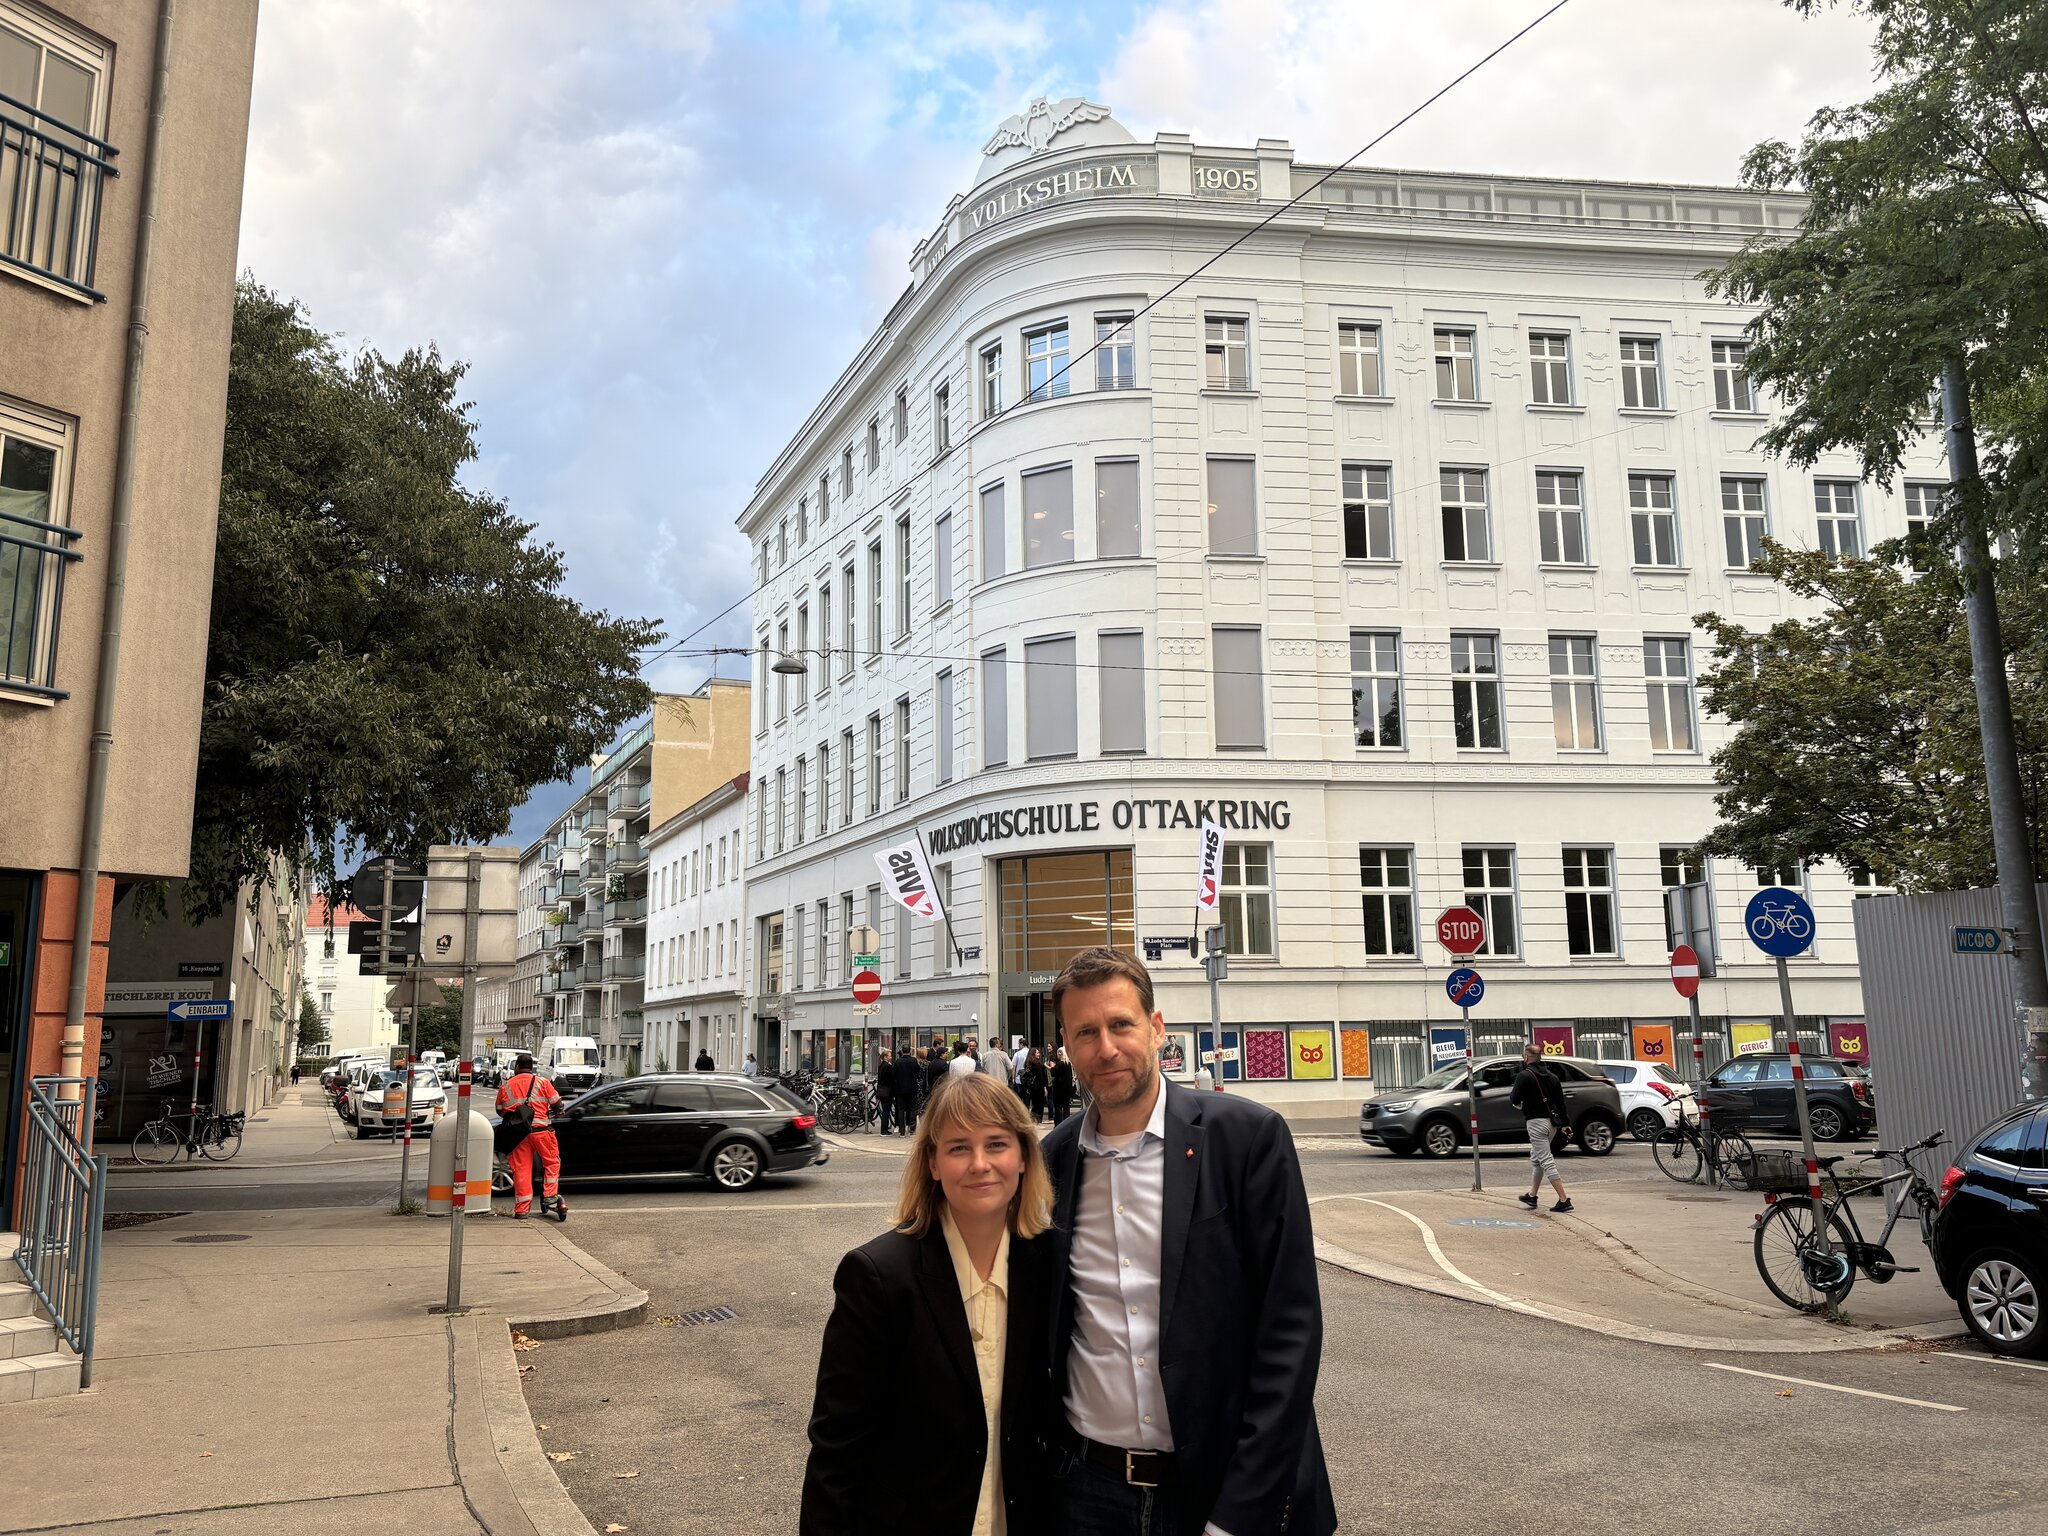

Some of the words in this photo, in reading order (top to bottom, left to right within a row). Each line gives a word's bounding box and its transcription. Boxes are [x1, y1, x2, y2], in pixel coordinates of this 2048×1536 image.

[1195, 169, 1258, 191] 1905
[971, 165, 1138, 229] VOLKSHEIM
[929, 802, 1099, 856] VOLKSHOCHSCHULE
[1112, 799, 1291, 830] OTTAKRING
[1441, 921, 1480, 940] STOP
[1957, 932, 1974, 948] WC
[104, 991, 175, 1001] TISCHLEREI
[177, 991, 211, 1000] KOUT
[188, 1004, 225, 1015] EINBAHN
[1436, 1043, 1455, 1052] BLEIB
[1740, 1041, 1768, 1052] GIERIG?
[1204, 1050, 1235, 1061] GIIG?
[150, 1074, 181, 1085] TISCHLER
